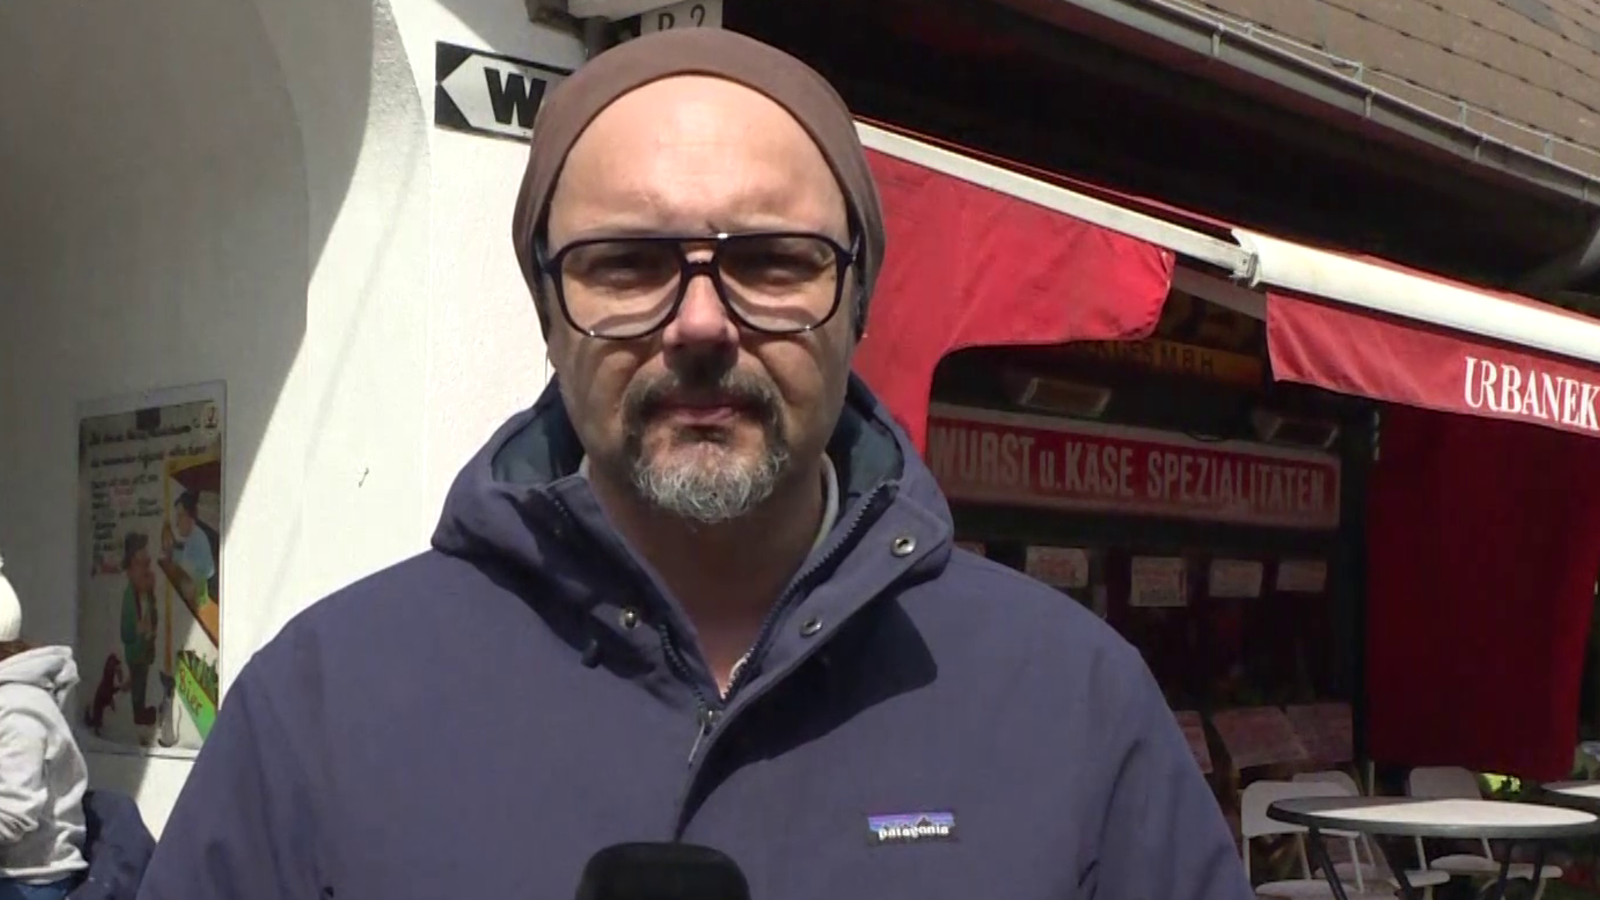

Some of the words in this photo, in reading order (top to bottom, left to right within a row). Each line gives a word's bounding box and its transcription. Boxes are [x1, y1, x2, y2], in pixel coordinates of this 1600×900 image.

[1464, 356, 1600, 431] URBANEK
[931, 427, 1035, 489] WURST
[1065, 441, 1134, 497] KÄSE
[1148, 451, 1326, 512] SPEZIALITÄTEN
[878, 825, 950, 841] patagonia
